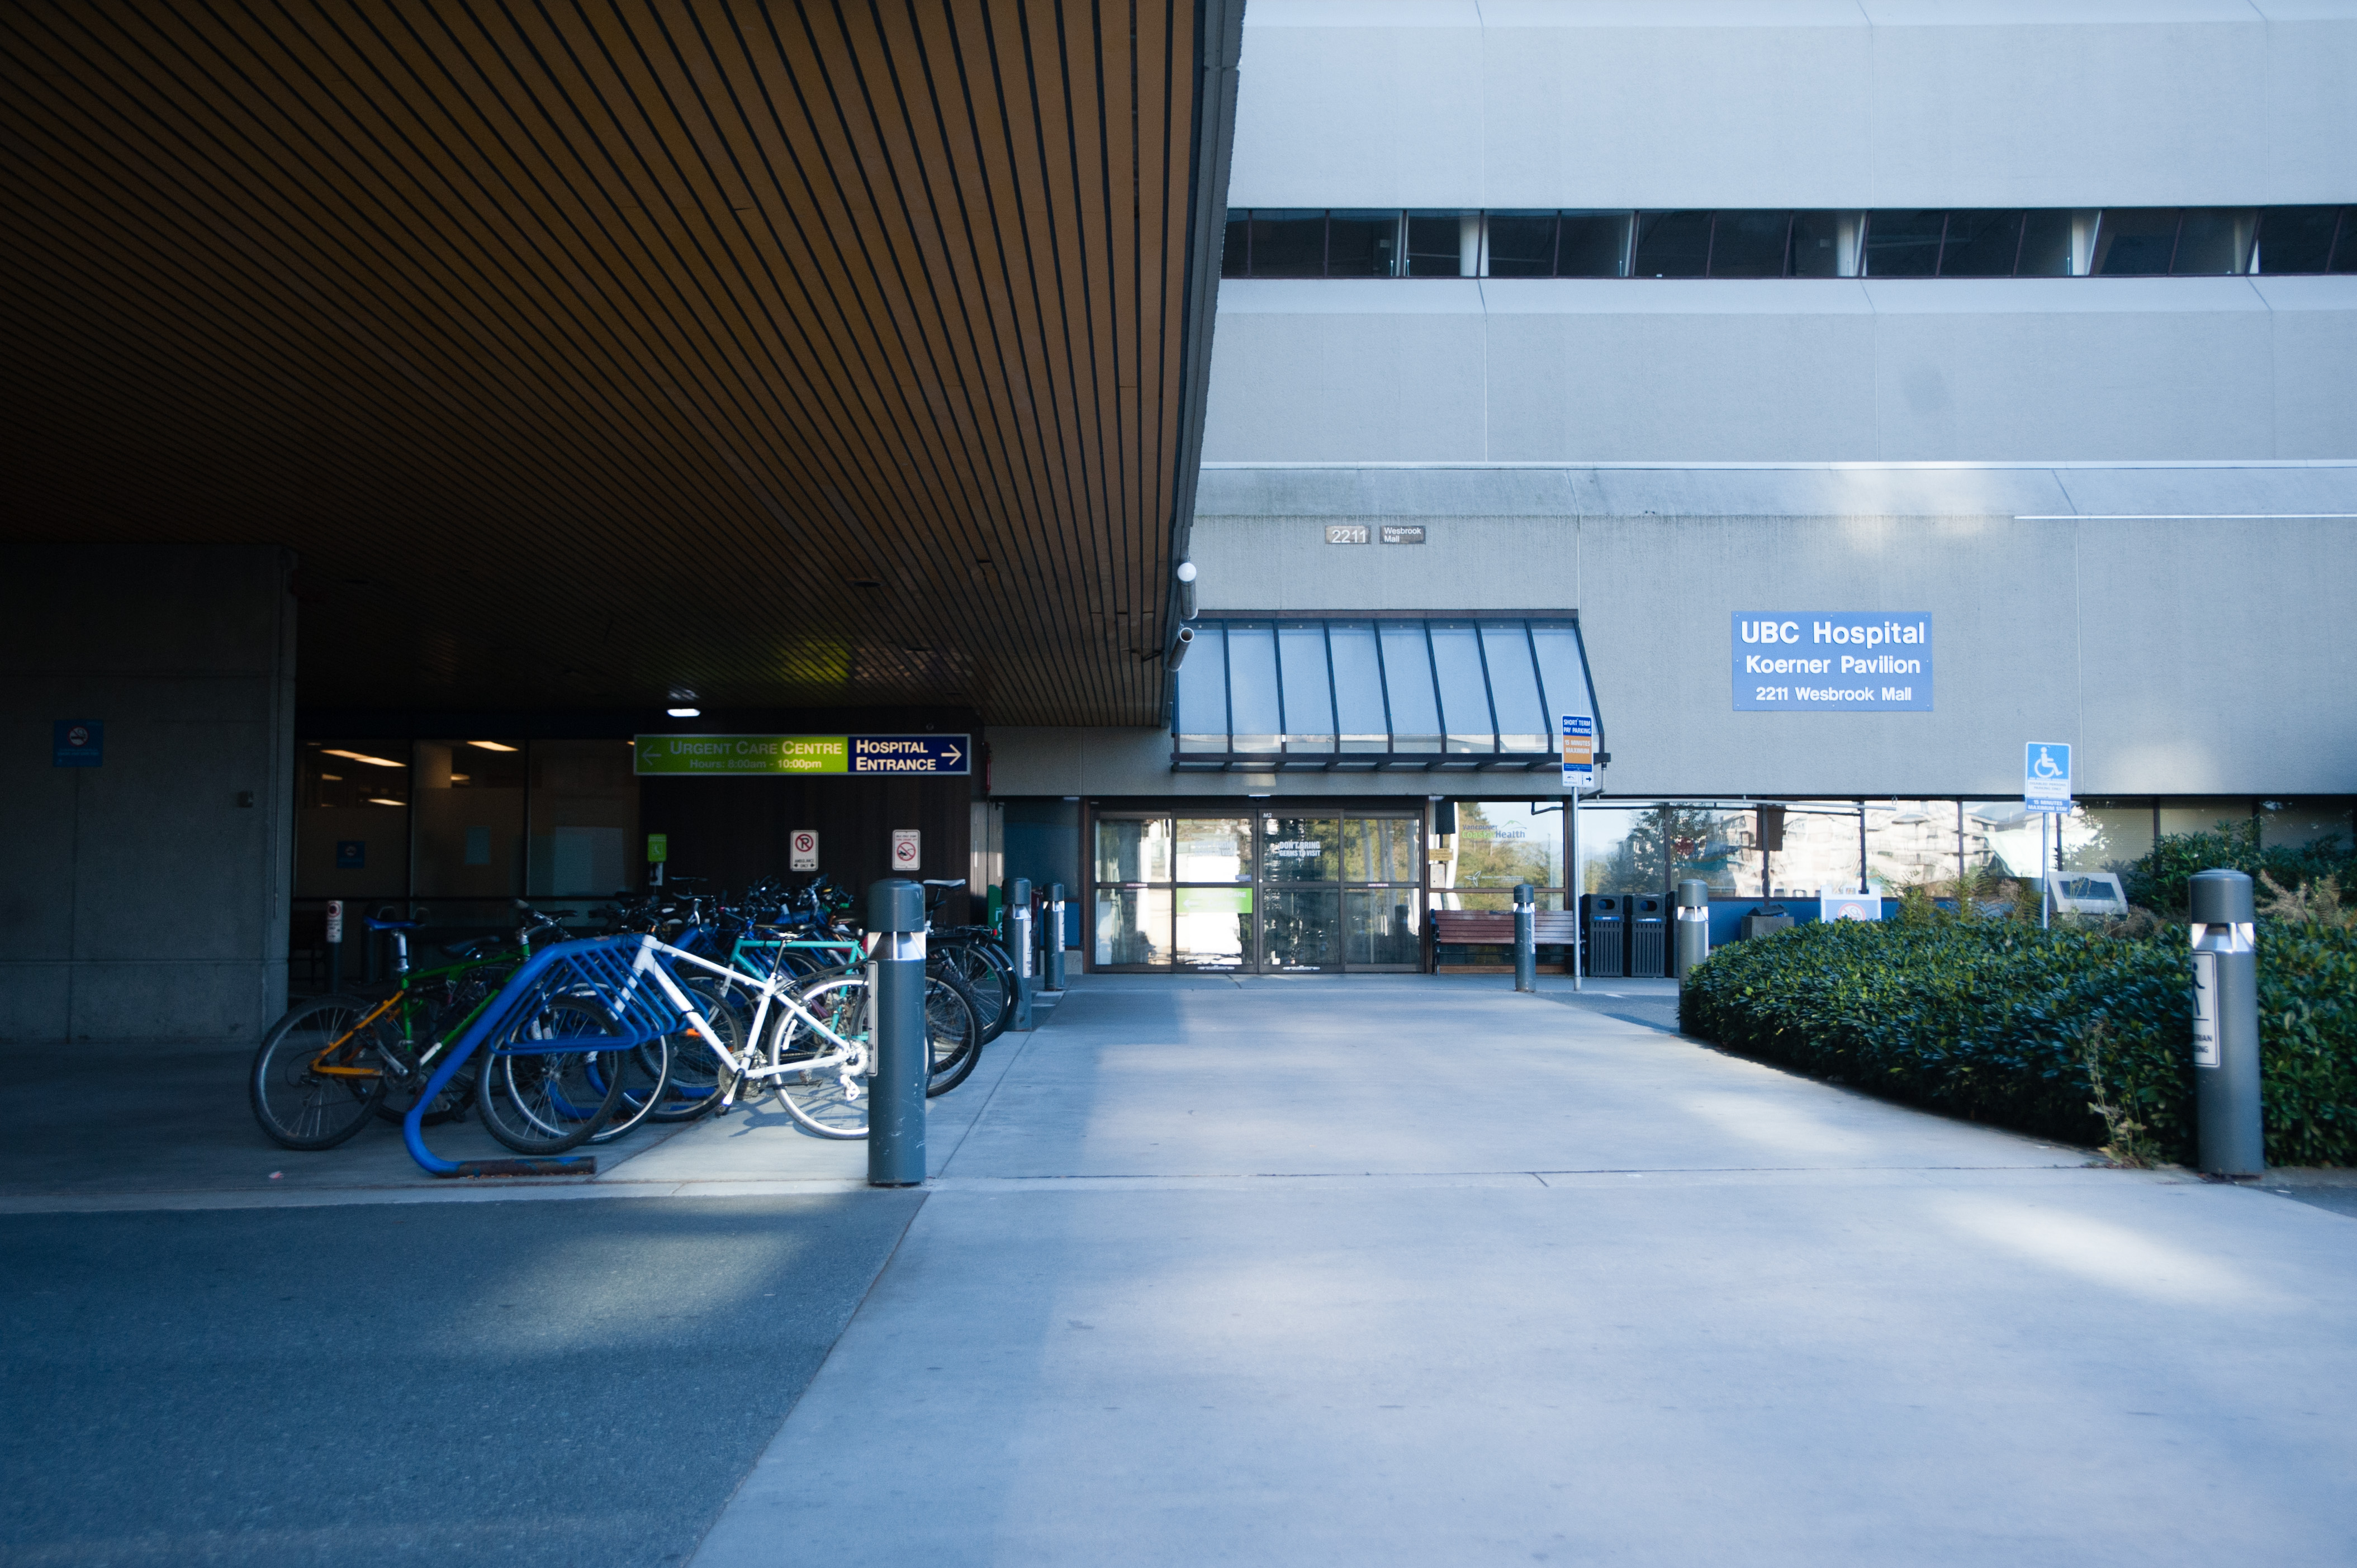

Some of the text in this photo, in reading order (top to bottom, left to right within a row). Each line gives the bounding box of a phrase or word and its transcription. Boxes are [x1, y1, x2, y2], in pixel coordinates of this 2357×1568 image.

[1331, 529, 1366, 543] 2211
[1741, 621, 1924, 649] UBC Hospital
[1746, 655, 1920, 674] Koerner Pavilion
[1756, 687, 1912, 701] 2211 Wesbrook Mall
[670, 740, 842, 754] URGENT CARE CENTRE
[856, 739, 928, 753] HOSPITAL
[689, 759, 725, 768] Hours:
[727, 759, 766, 768] 8:00am
[778, 759, 822, 770] 10:00pm
[856, 757, 936, 771] ENTRANCE
